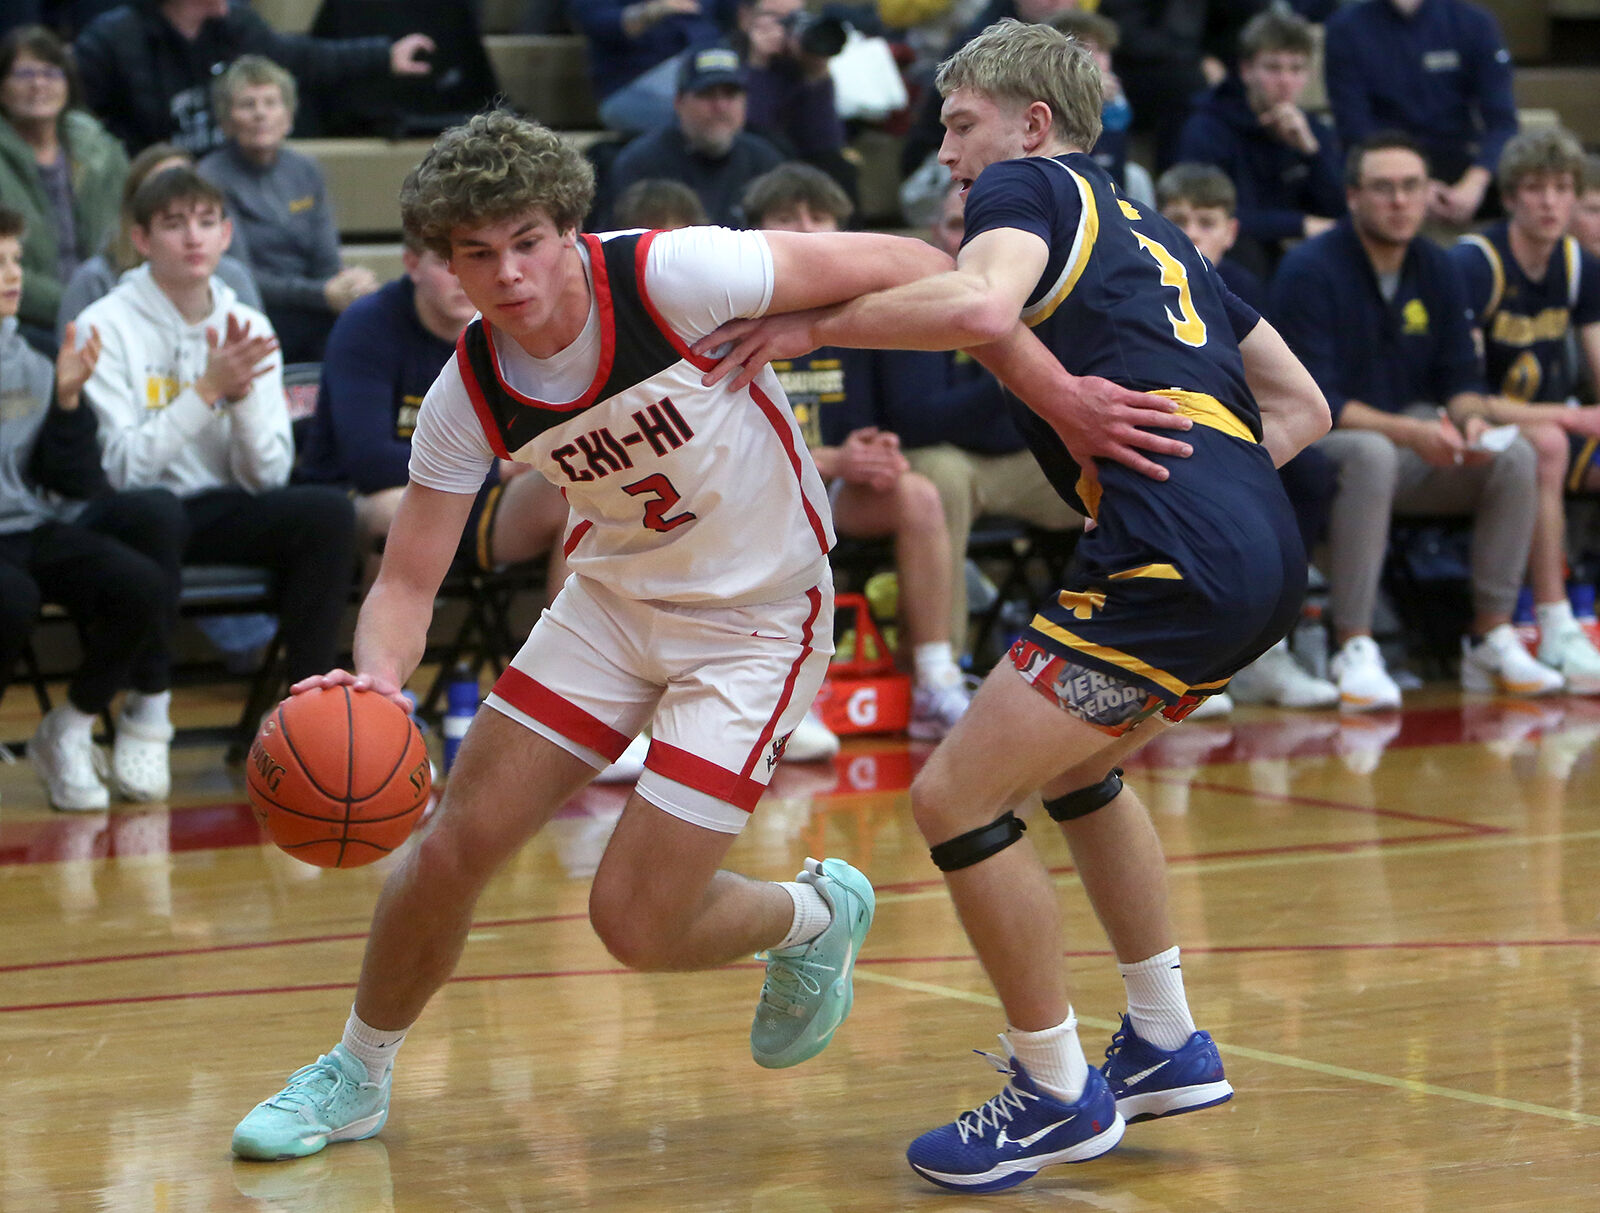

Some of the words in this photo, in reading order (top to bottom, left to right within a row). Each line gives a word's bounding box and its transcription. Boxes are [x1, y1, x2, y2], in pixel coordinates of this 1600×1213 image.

[551, 396, 695, 482] CHI-HI
[621, 473, 697, 532] 2
[847, 687, 878, 727] G
